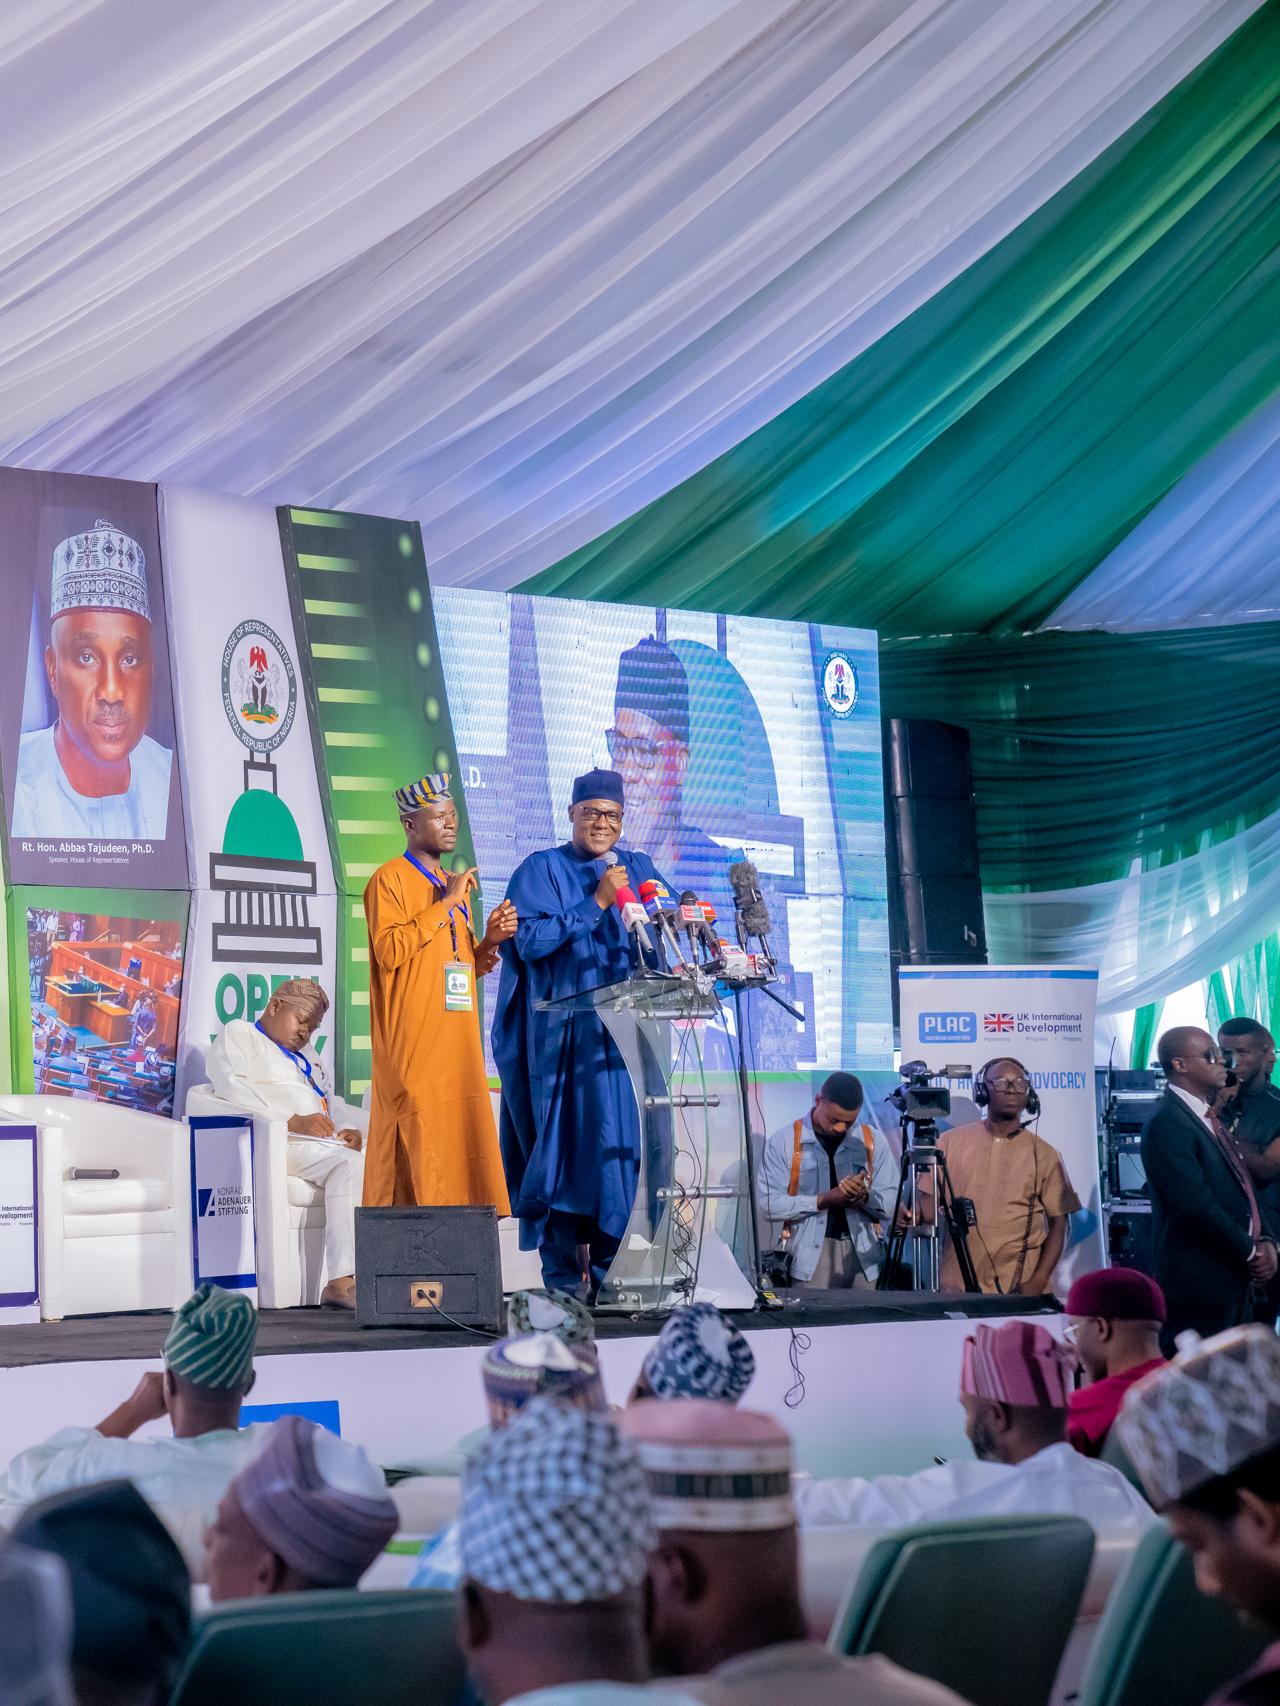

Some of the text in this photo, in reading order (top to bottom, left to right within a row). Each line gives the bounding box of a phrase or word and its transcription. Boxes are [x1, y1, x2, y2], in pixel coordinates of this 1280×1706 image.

[223, 634, 238, 668] HOUSE
[245, 622, 294, 677] REPRESENTATIVES
[224, 692, 241, 738] FEDERAL
[241, 732, 272, 751] REPUBLIC
[280, 701, 296, 737] NIGERIA
[22, 842, 155, 855] Rt. Hon. Abbas Tajudeen, Ph.D.
[1017, 1013, 1082, 1021] UK International
[925, 1016, 971, 1033] PLAC
[1017, 1023, 1082, 1034] Development
[1030, 1071, 1086, 1089] DVOCACY
[217, 1186, 243, 1196] KONRAD
[217, 1196, 252, 1206] ADENAUER
[217, 1206, 249, 1216] STIFTUNG
